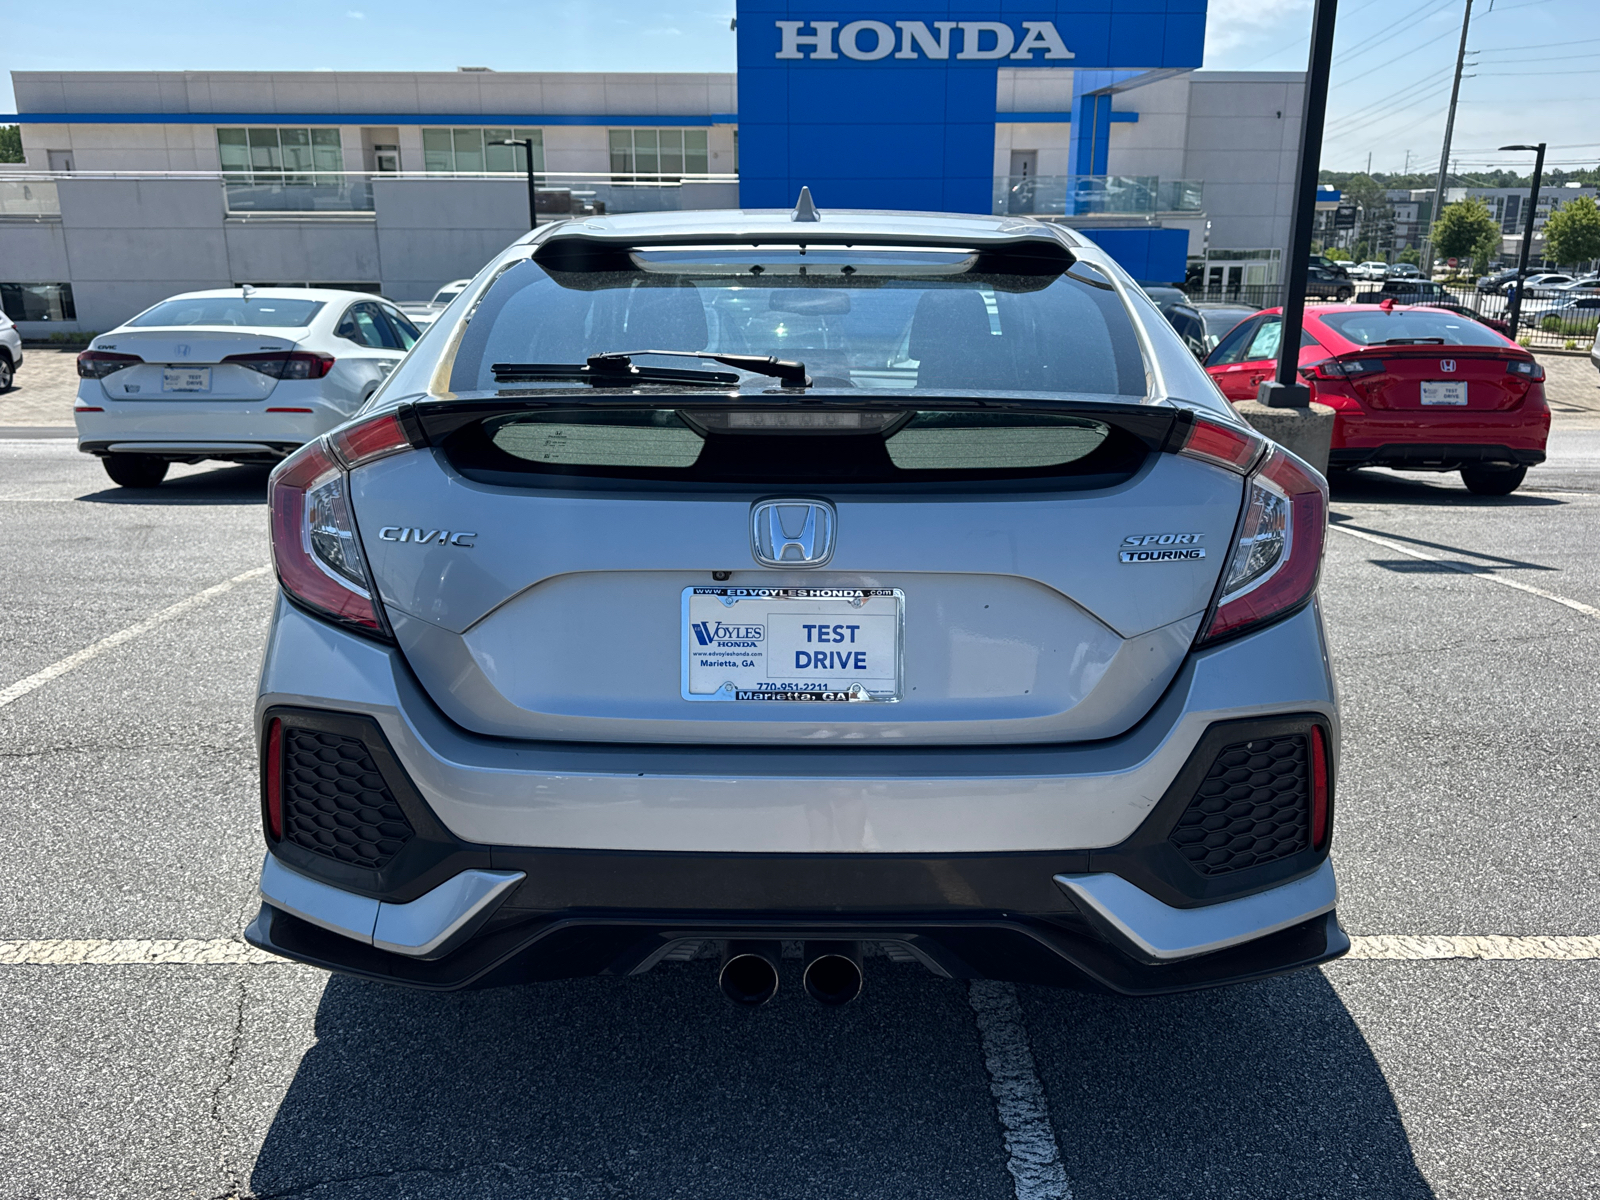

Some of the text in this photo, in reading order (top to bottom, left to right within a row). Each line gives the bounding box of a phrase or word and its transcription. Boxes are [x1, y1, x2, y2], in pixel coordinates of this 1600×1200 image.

[775, 20, 1075, 60] HONDA
[378, 526, 477, 548] CIVIC
[1121, 533, 1205, 547] SPORT
[1126, 550, 1201, 561] TOURING
[802, 624, 860, 643] TEST
[693, 650, 763, 658] www.edvoyleshonda.com
[795, 650, 867, 670] DRIVE
[700, 659, 755, 668] Marietta, GA
[756, 682, 828, 691] 770-951-2211
[738, 691, 847, 700] Marietta, GA
